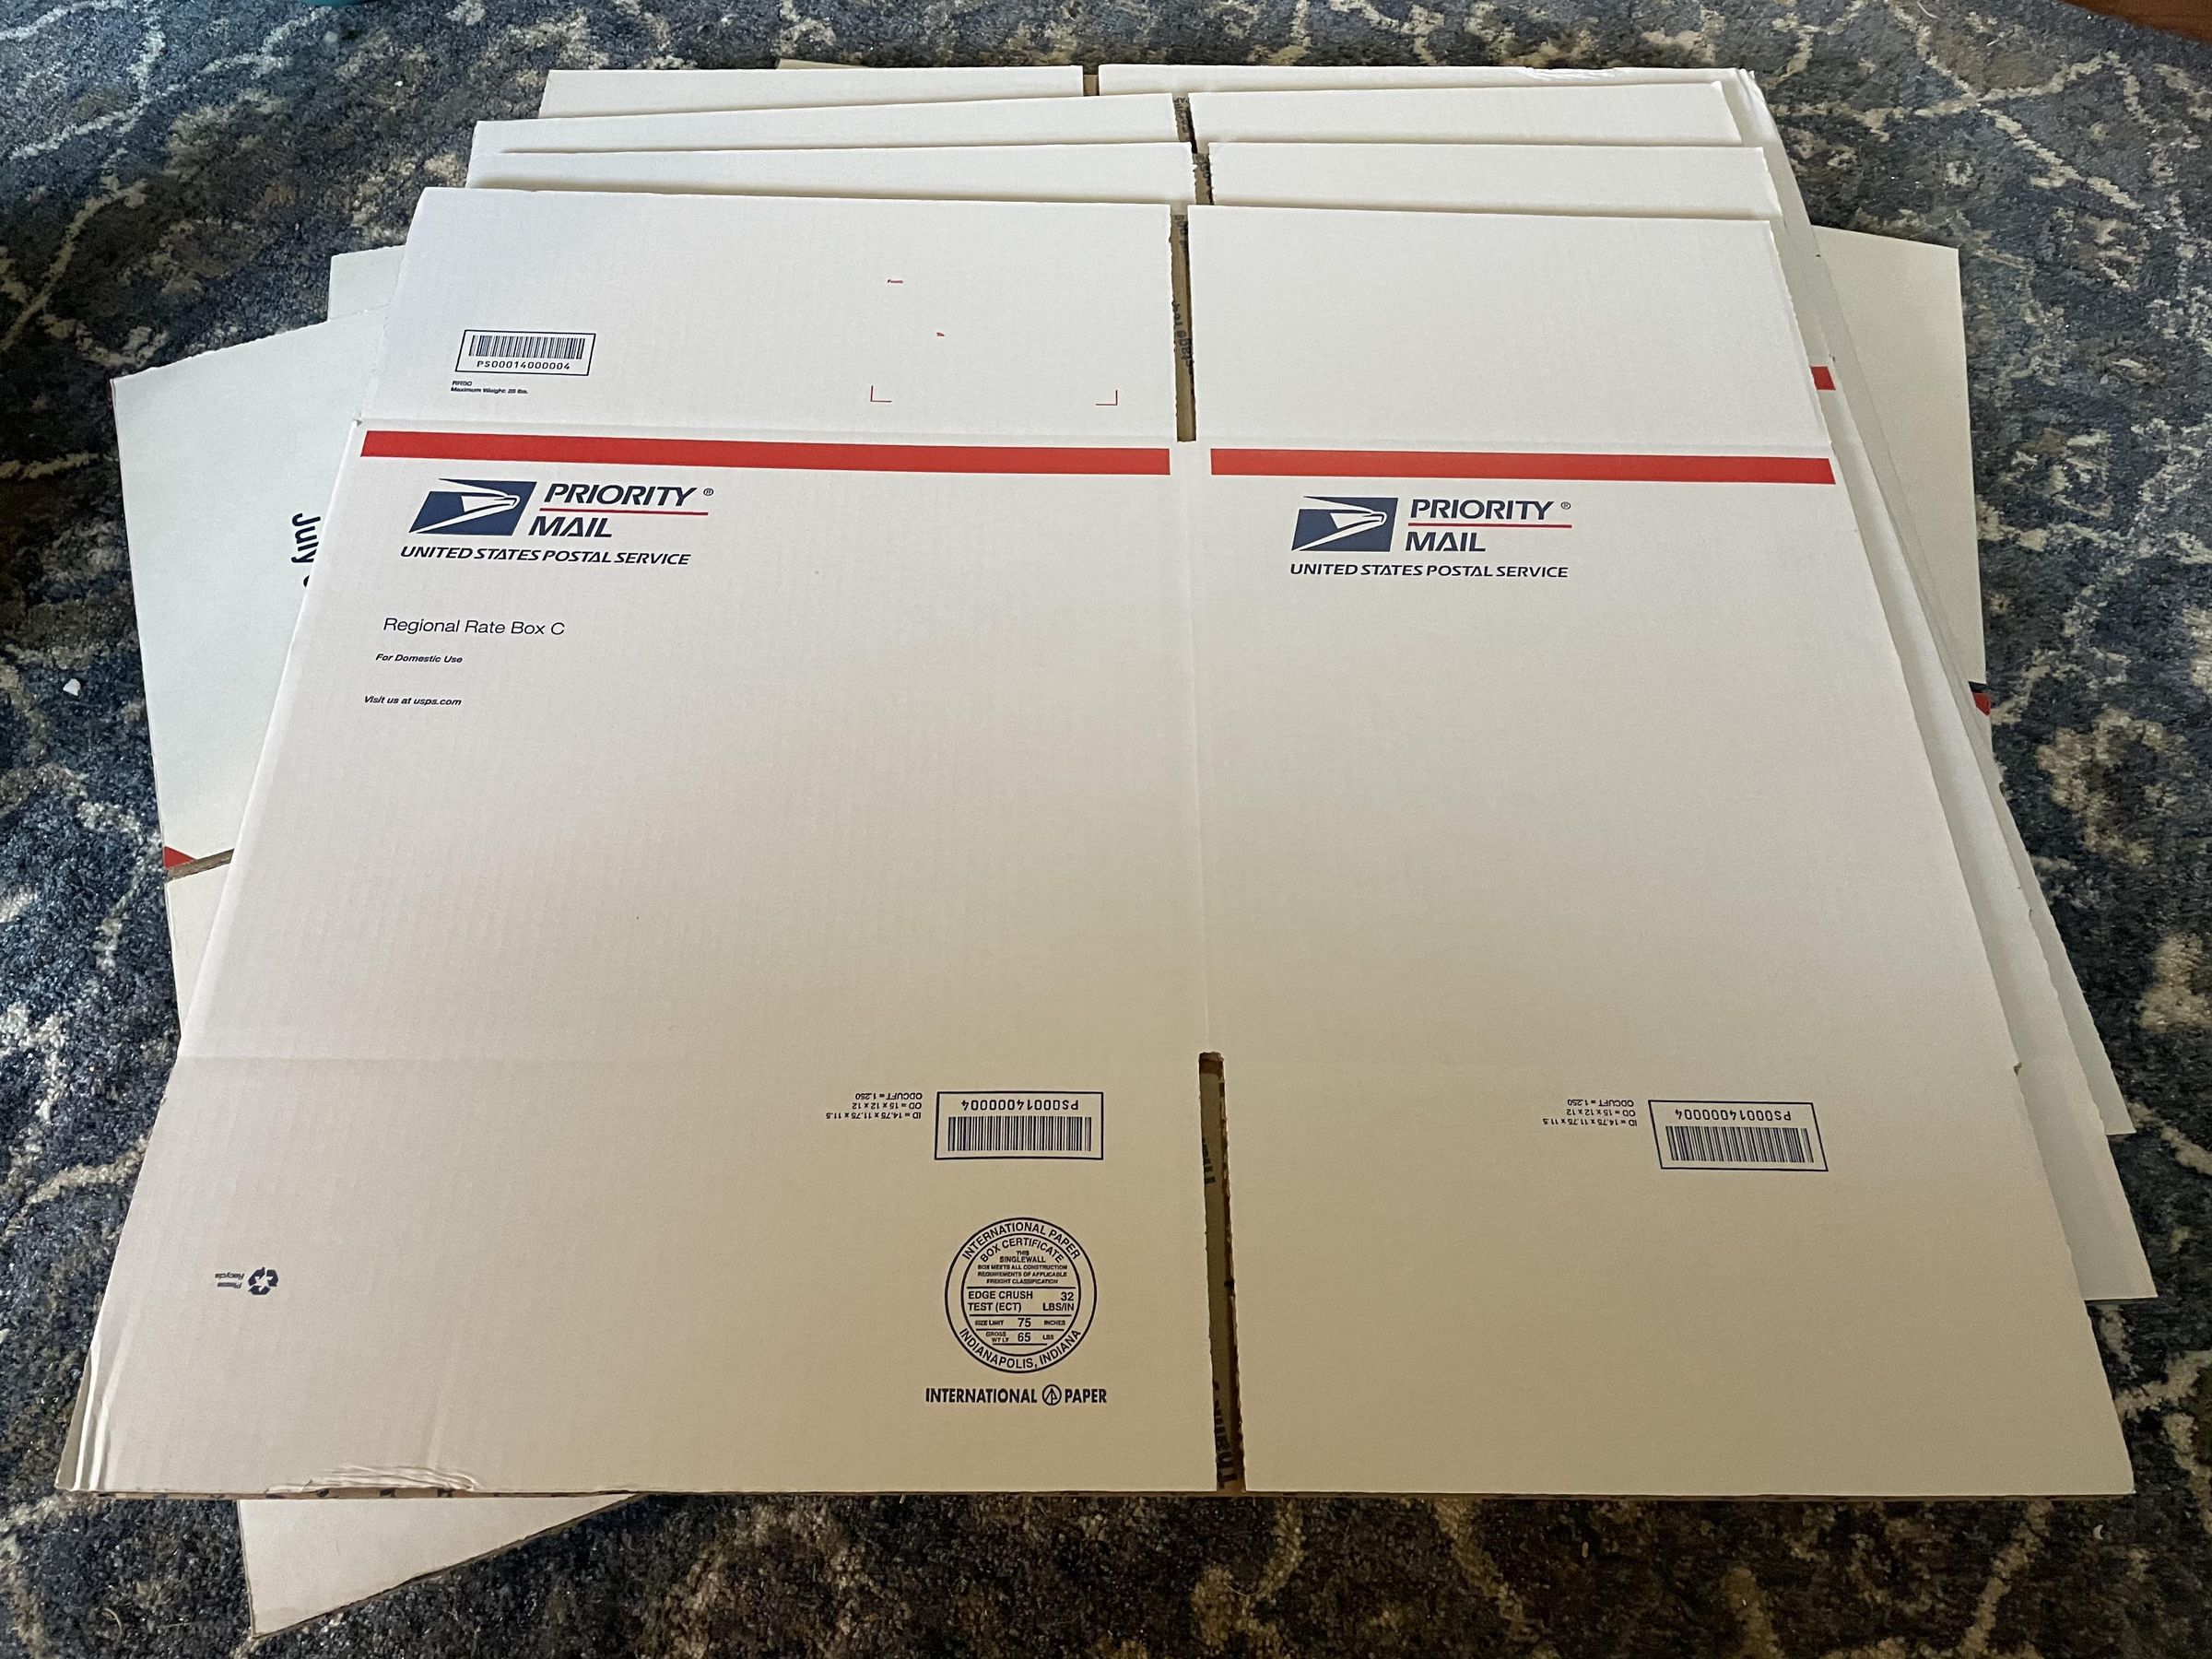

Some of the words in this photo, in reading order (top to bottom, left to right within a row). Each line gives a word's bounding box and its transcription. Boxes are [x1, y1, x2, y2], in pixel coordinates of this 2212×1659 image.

[477, 360, 571, 371] PS00014000004
[544, 483, 697, 506] PRIORITY
[1410, 499, 1554, 520] PRIORITY
[528, 516, 613, 538] MAIL
[291, 512, 321, 563] July
[1406, 532, 1486, 552] MAIL
[400, 546, 473, 559] UNITED
[477, 548, 542, 561] STATES
[542, 550, 612, 563] POSTAL
[613, 553, 692, 566] SERVICE
[1290, 563, 1359, 575] UNITED
[1360, 565, 1423, 576] STATES
[1426, 565, 1493, 577] POSTAL
[1496, 567, 1569, 578] SERVICE
[382, 618, 460, 634] Regional
[465, 619, 505, 634] Rate
[511, 621, 546, 635] Box
[550, 621, 565, 636] C
[375, 653, 394, 662] For
[394, 653, 441, 664] Domestic
[443, 655, 464, 664] Use
[364, 696, 385, 704] Visit
[414, 698, 462, 706] usps.com
[886, 1092, 923, 1100] ODCUFT
[961, 1100, 1078, 1111] PS00014000004
[1598, 1099, 1634, 1107] ODCUFT
[1622, 1109, 1636, 1117] OD
[1676, 1109, 1791, 1121] PS00014000004
[1597, 1118, 1618, 1126] 14.75
[961, 1221, 1046, 1260] INTERNATIONAL
[1048, 1230, 1081, 1260] PAPER
[980, 1245, 1001, 1263] BOX
[1002, 1237, 1065, 1263] CERTIFICATE
[968, 1290, 996, 1300] EDGE
[998, 1290, 1033, 1300] CRUSH
[1061, 1291, 1075, 1301] 32
[968, 1302, 994, 1312] TEST
[995, 1302, 1022, 1312] (ECT)
[1042, 1302, 1075, 1312] LBS/IN
[1018, 1318, 1031, 1327] 75
[1018, 1332, 1031, 1342] 65
[959, 1328, 1038, 1369] INDIANAPOLIS,
[1039, 1329, 1081, 1364] INDIANA
[925, 1388, 1037, 1403] INTERNATIONAL
[1065, 1388, 1107, 1403] PAPER
